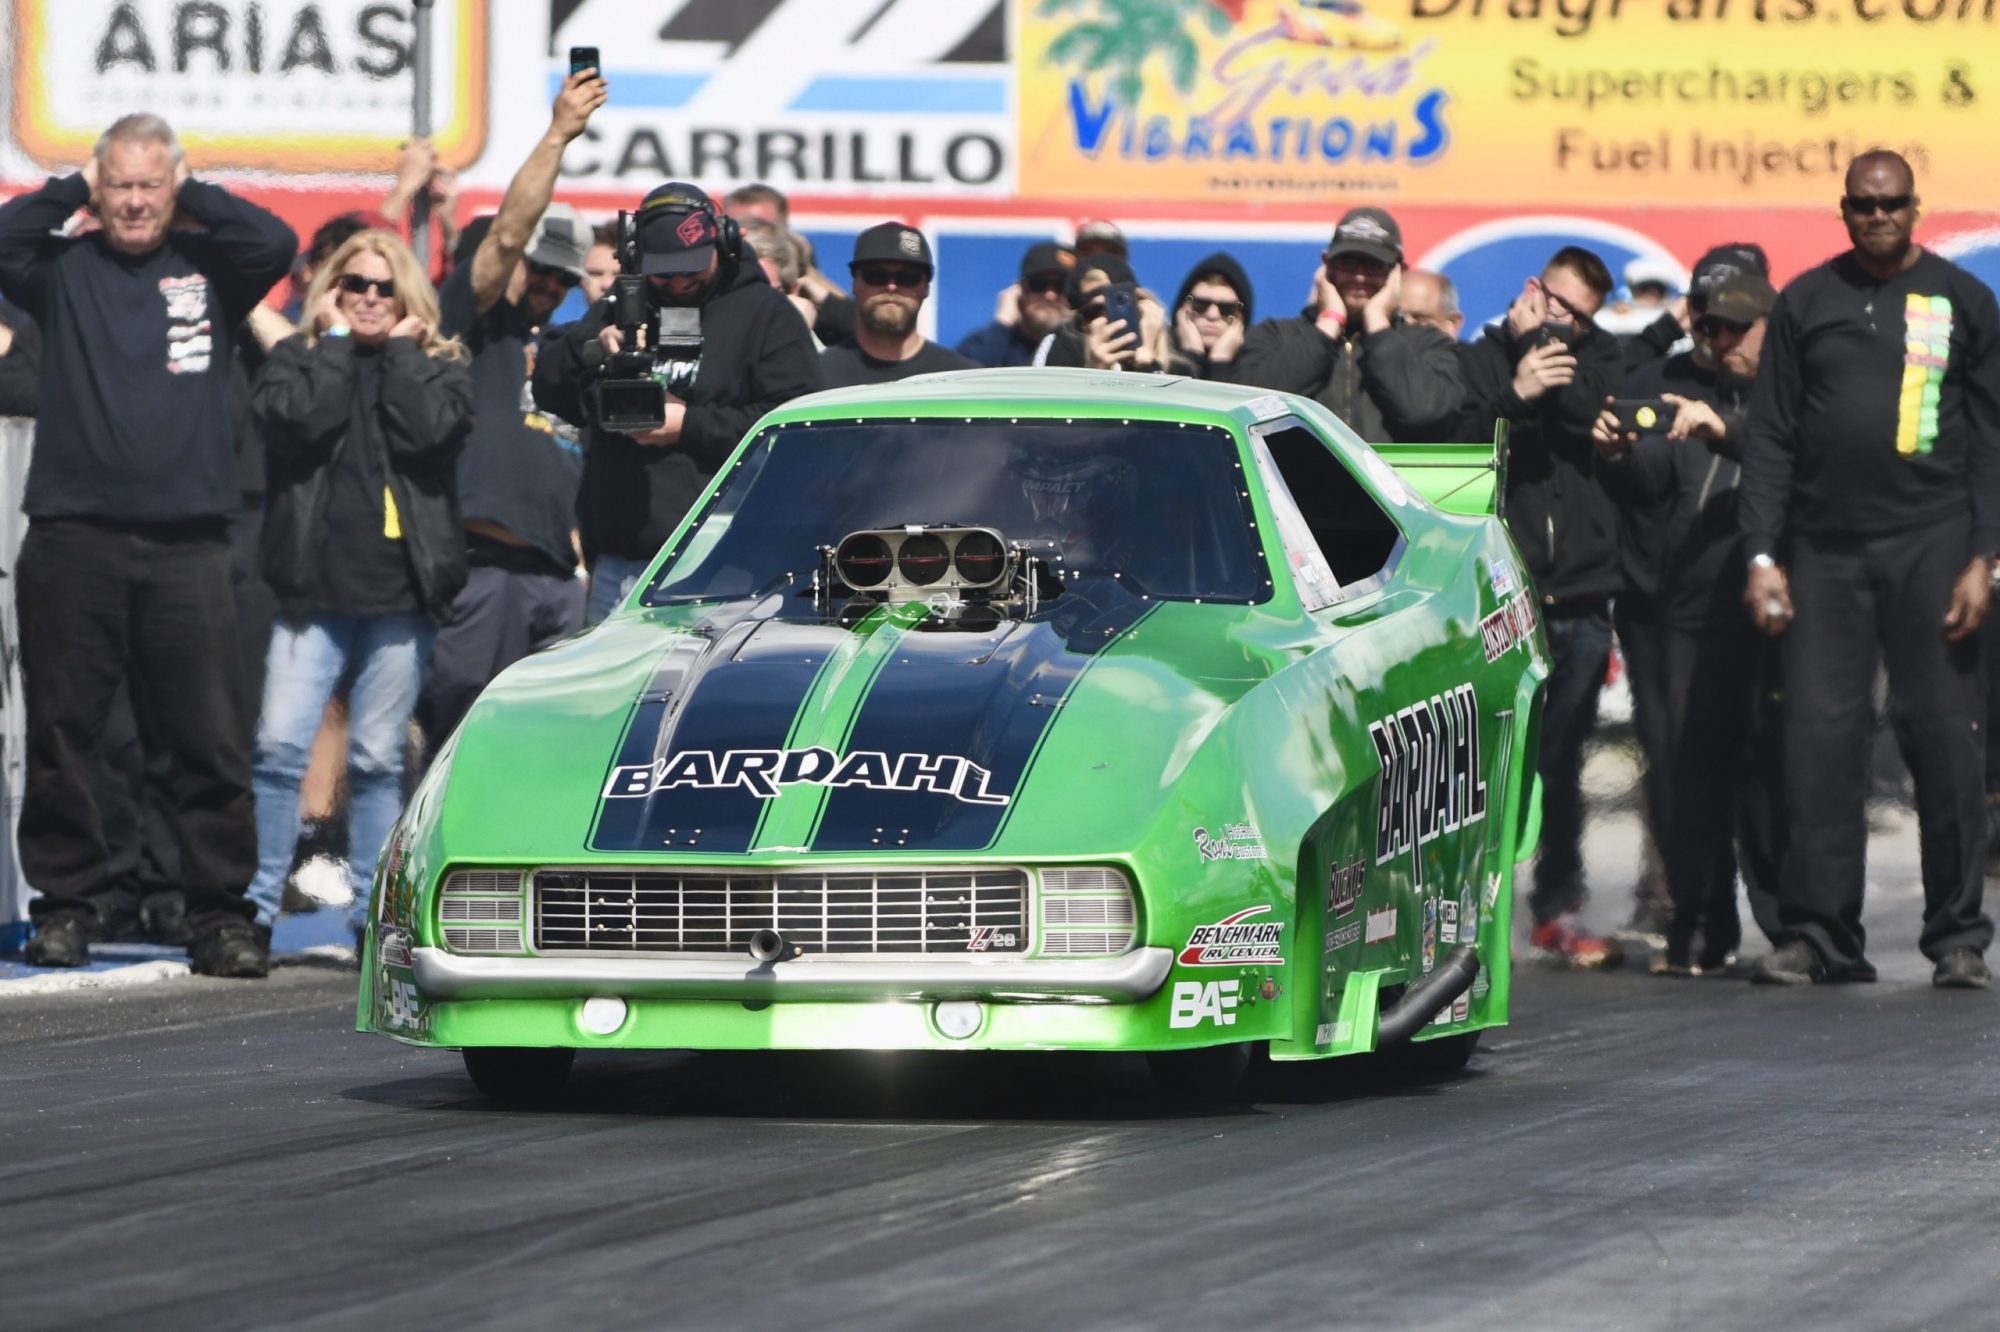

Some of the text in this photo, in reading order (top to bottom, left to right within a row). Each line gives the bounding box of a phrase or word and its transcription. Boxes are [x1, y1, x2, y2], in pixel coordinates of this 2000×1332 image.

[95, 2, 413, 79] ARIAS
[1511, 56, 1975, 114] Superchargers &
[562, 126, 1002, 184] CARRILLO
[1554, 128, 1932, 184] Fuel Injectin
[1022, 480, 1086, 493] IMPACT
[602, 746, 1010, 804] BARDAHL
[1368, 681, 1486, 894] BARDAHL
[1190, 923, 1284, 946] BENCHMARK
[1206, 946, 1279, 959] RV CENTER
[1170, 979, 1240, 1029] BAE
